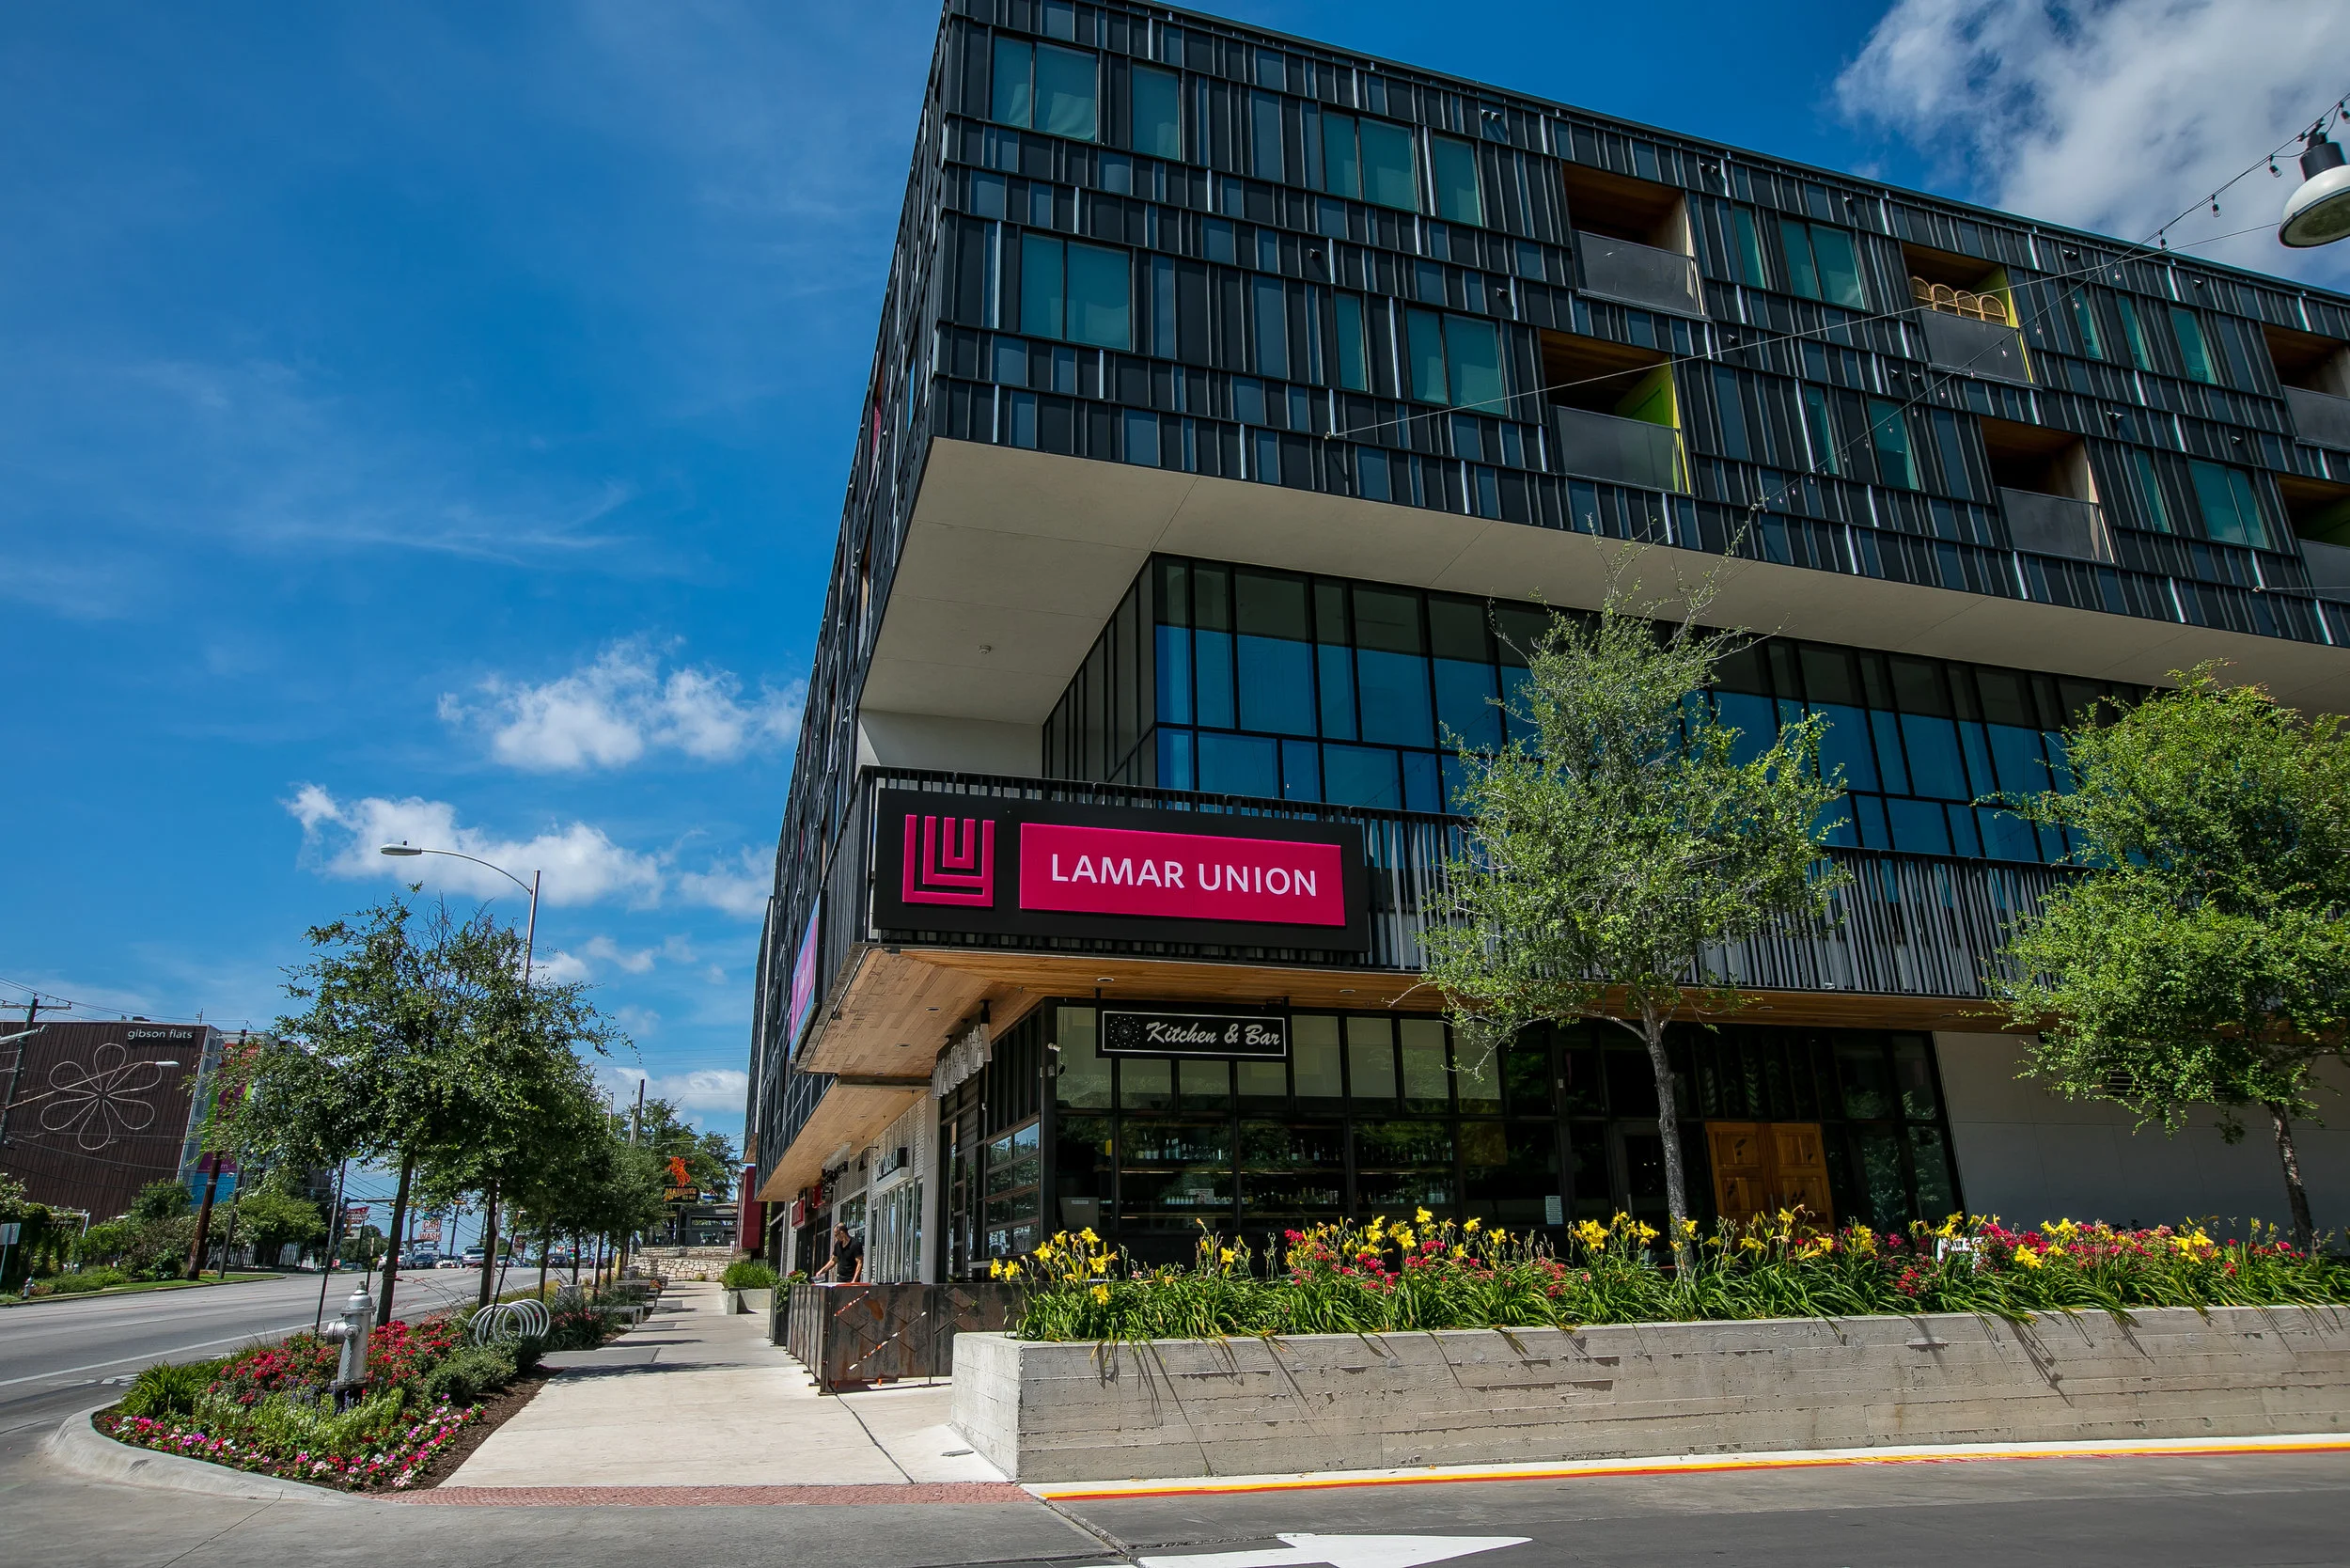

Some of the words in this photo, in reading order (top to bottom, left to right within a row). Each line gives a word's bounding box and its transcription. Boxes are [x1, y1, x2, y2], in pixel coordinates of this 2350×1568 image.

[1052, 854, 1184, 888] LAMAR
[1198, 863, 1316, 896] UNION
[128, 1028, 165, 1040] gibson
[169, 1029, 193, 1039] flats
[1146, 1021, 1216, 1043] Kitchen
[1224, 1023, 1239, 1043] &
[1245, 1024, 1279, 1045] Bar
